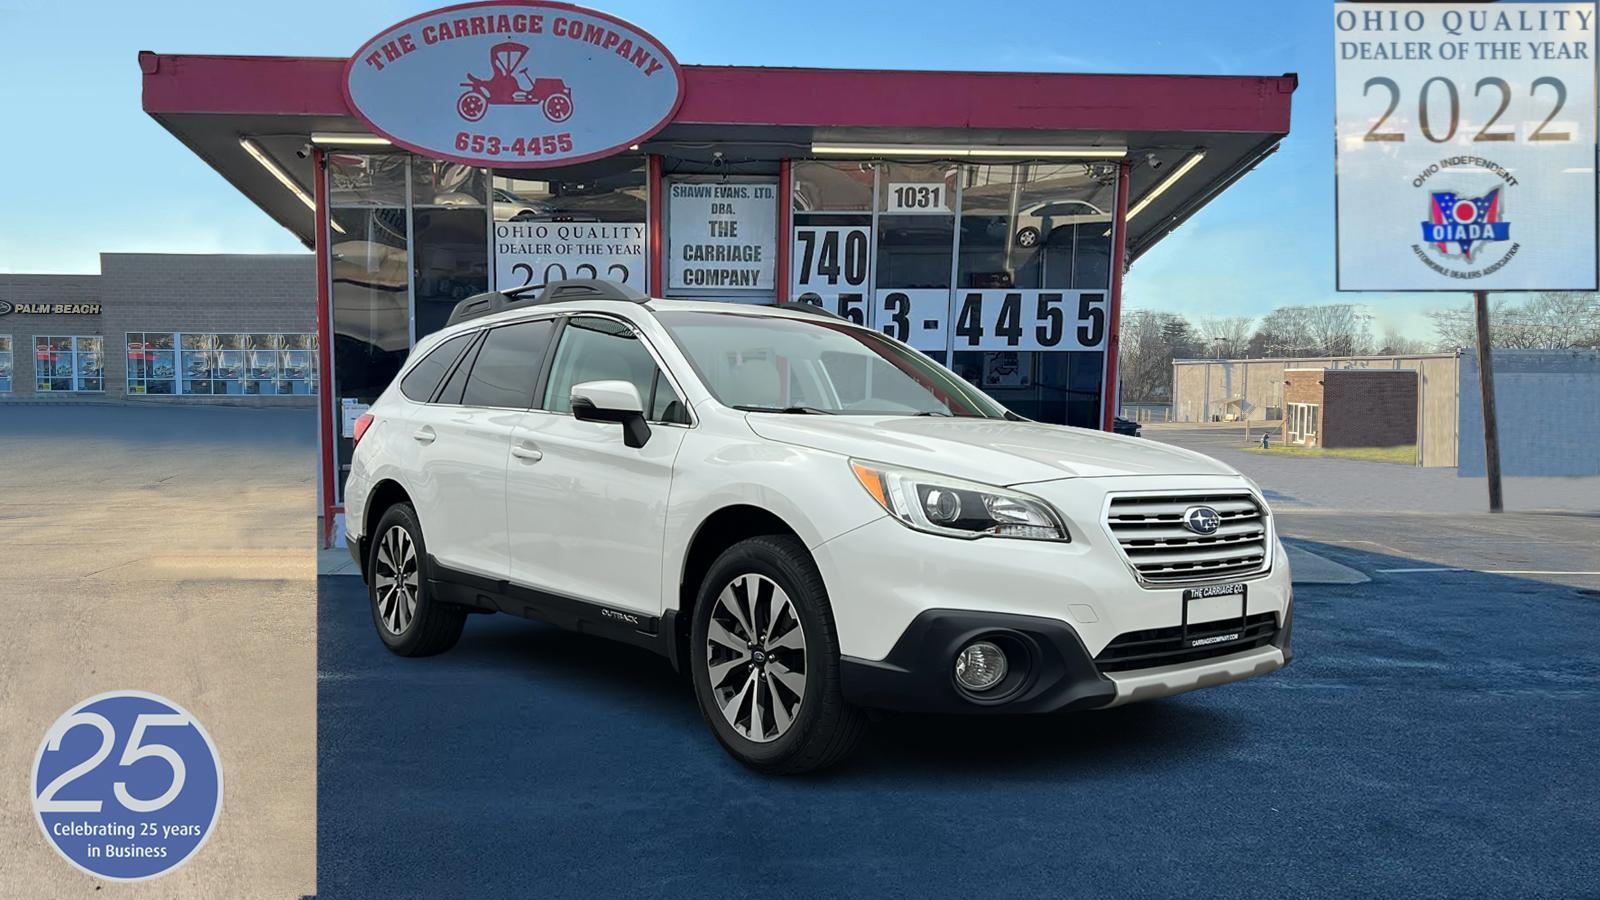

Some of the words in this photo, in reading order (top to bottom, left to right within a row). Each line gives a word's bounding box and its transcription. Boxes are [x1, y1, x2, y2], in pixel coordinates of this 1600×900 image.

[1336, 10, 1425, 32] OHIO
[1442, 10, 1593, 36] QUALITY
[366, 33, 417, 72] THE
[422, 14, 544, 45] CARRIAGE
[552, 17, 664, 77] COMPANY
[1341, 42, 1433, 61] DEALER
[1439, 42, 1469, 61] OF
[1475, 42, 1522, 60] THE
[1527, 42, 1589, 60] YEAR
[1362, 76, 1571, 143] 2022
[454, 132, 573, 157] 653-4455
[1413, 164, 1440, 188] OHIO
[1440, 155, 1519, 187] INDEPENDENT
[672, 185, 712, 199] SHAWN
[754, 187, 775, 200] LTD.
[894, 186, 941, 209] 1031
[711, 203, 736, 215] DBA.
[496, 226, 548, 239] OHIO
[557, 226, 644, 241] QUALITY
[708, 220, 738, 238] THE
[1432, 224, 1495, 241] OIADA
[500, 243, 552, 255] DEALER
[555, 243, 574, 255] OF
[576, 244, 603, 255] THE
[607, 244, 641, 255] YEAR
[683, 244, 762, 262] CARRIAGE
[797, 230, 868, 286] 740
[683, 268, 760, 286] COMPANY
[15, 303, 51, 314] PALM
[54, 304, 100, 314] BEACH
[798, 292, 1105, 347] 53-4455
[1191, 589, 1203, 598] THE
[1203, 586, 1233, 597] CARRIAGE
